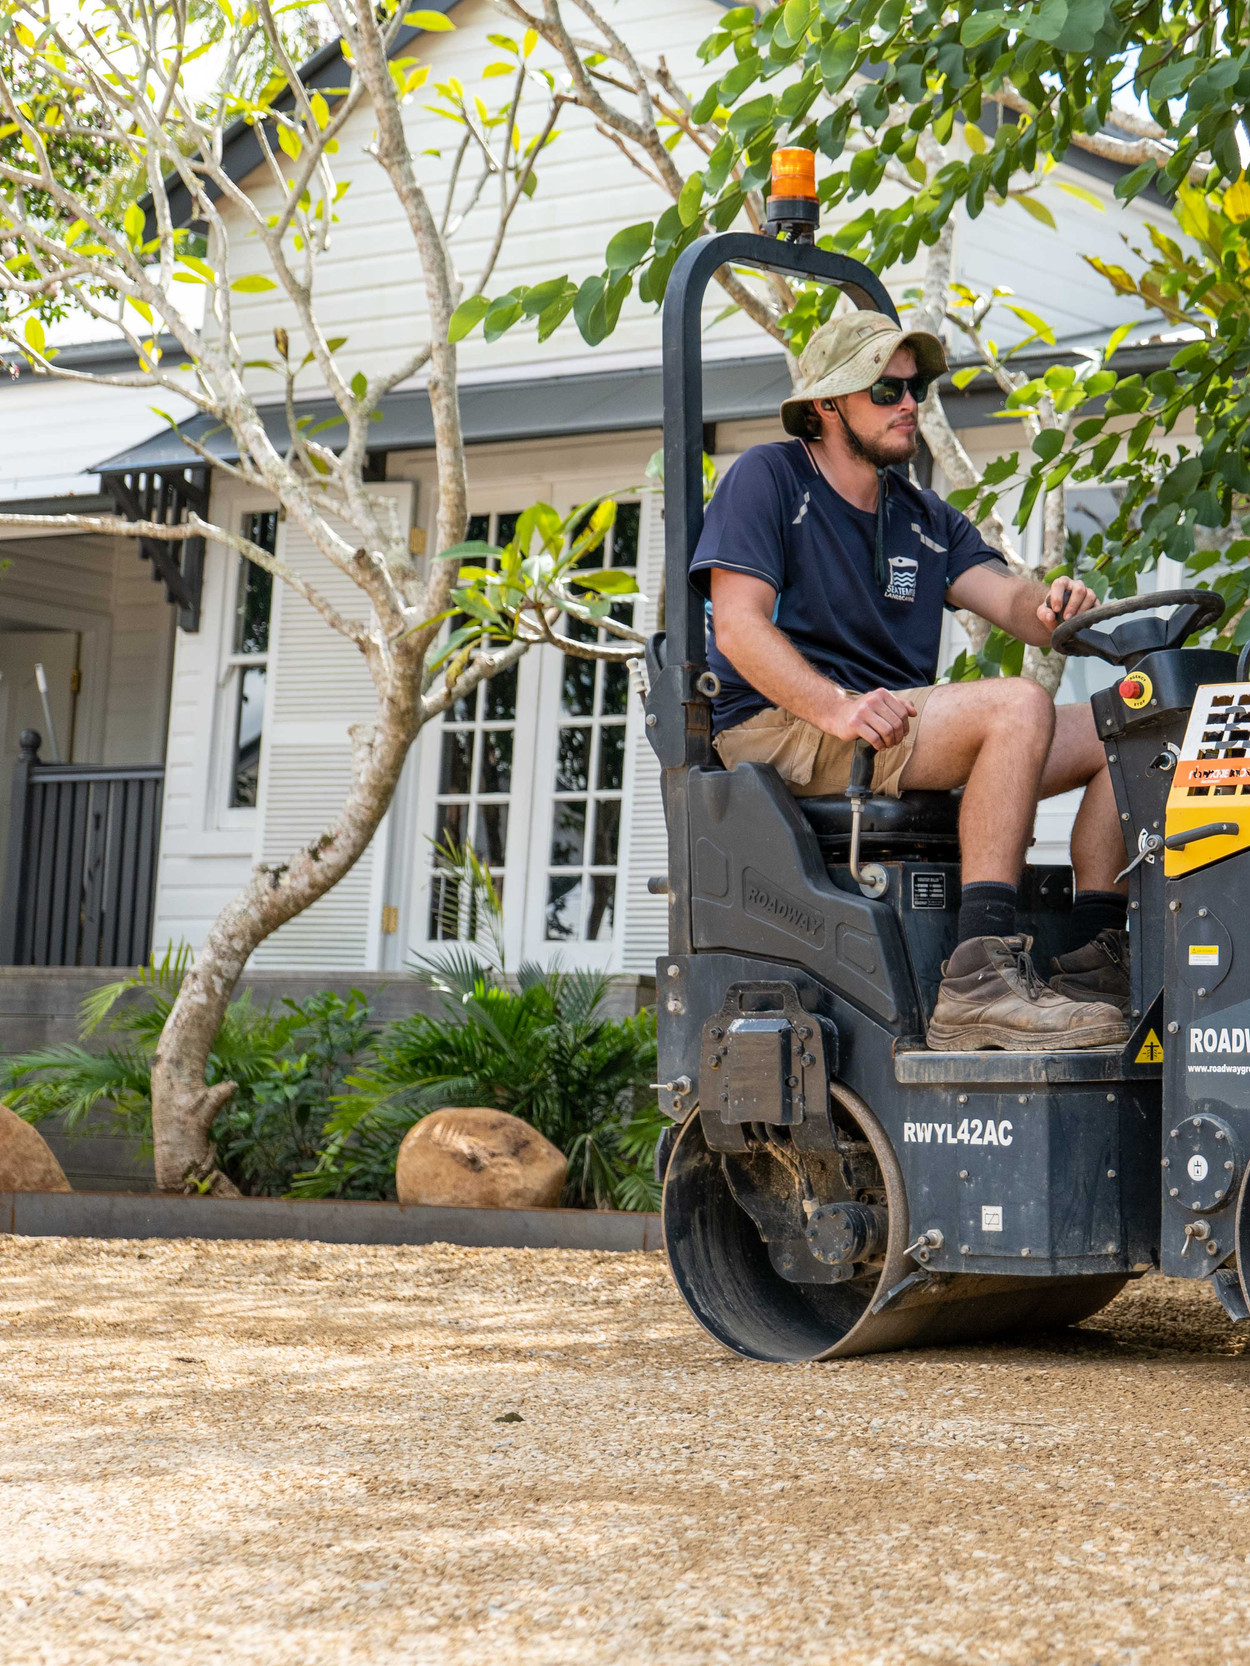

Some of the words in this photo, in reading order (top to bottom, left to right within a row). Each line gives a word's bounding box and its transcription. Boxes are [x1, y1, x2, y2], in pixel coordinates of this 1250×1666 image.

[1133, 699, 1146, 707] STOP
[749, 888, 823, 935] ROADWAY
[903, 1118, 1013, 1146] RWYL42AC
